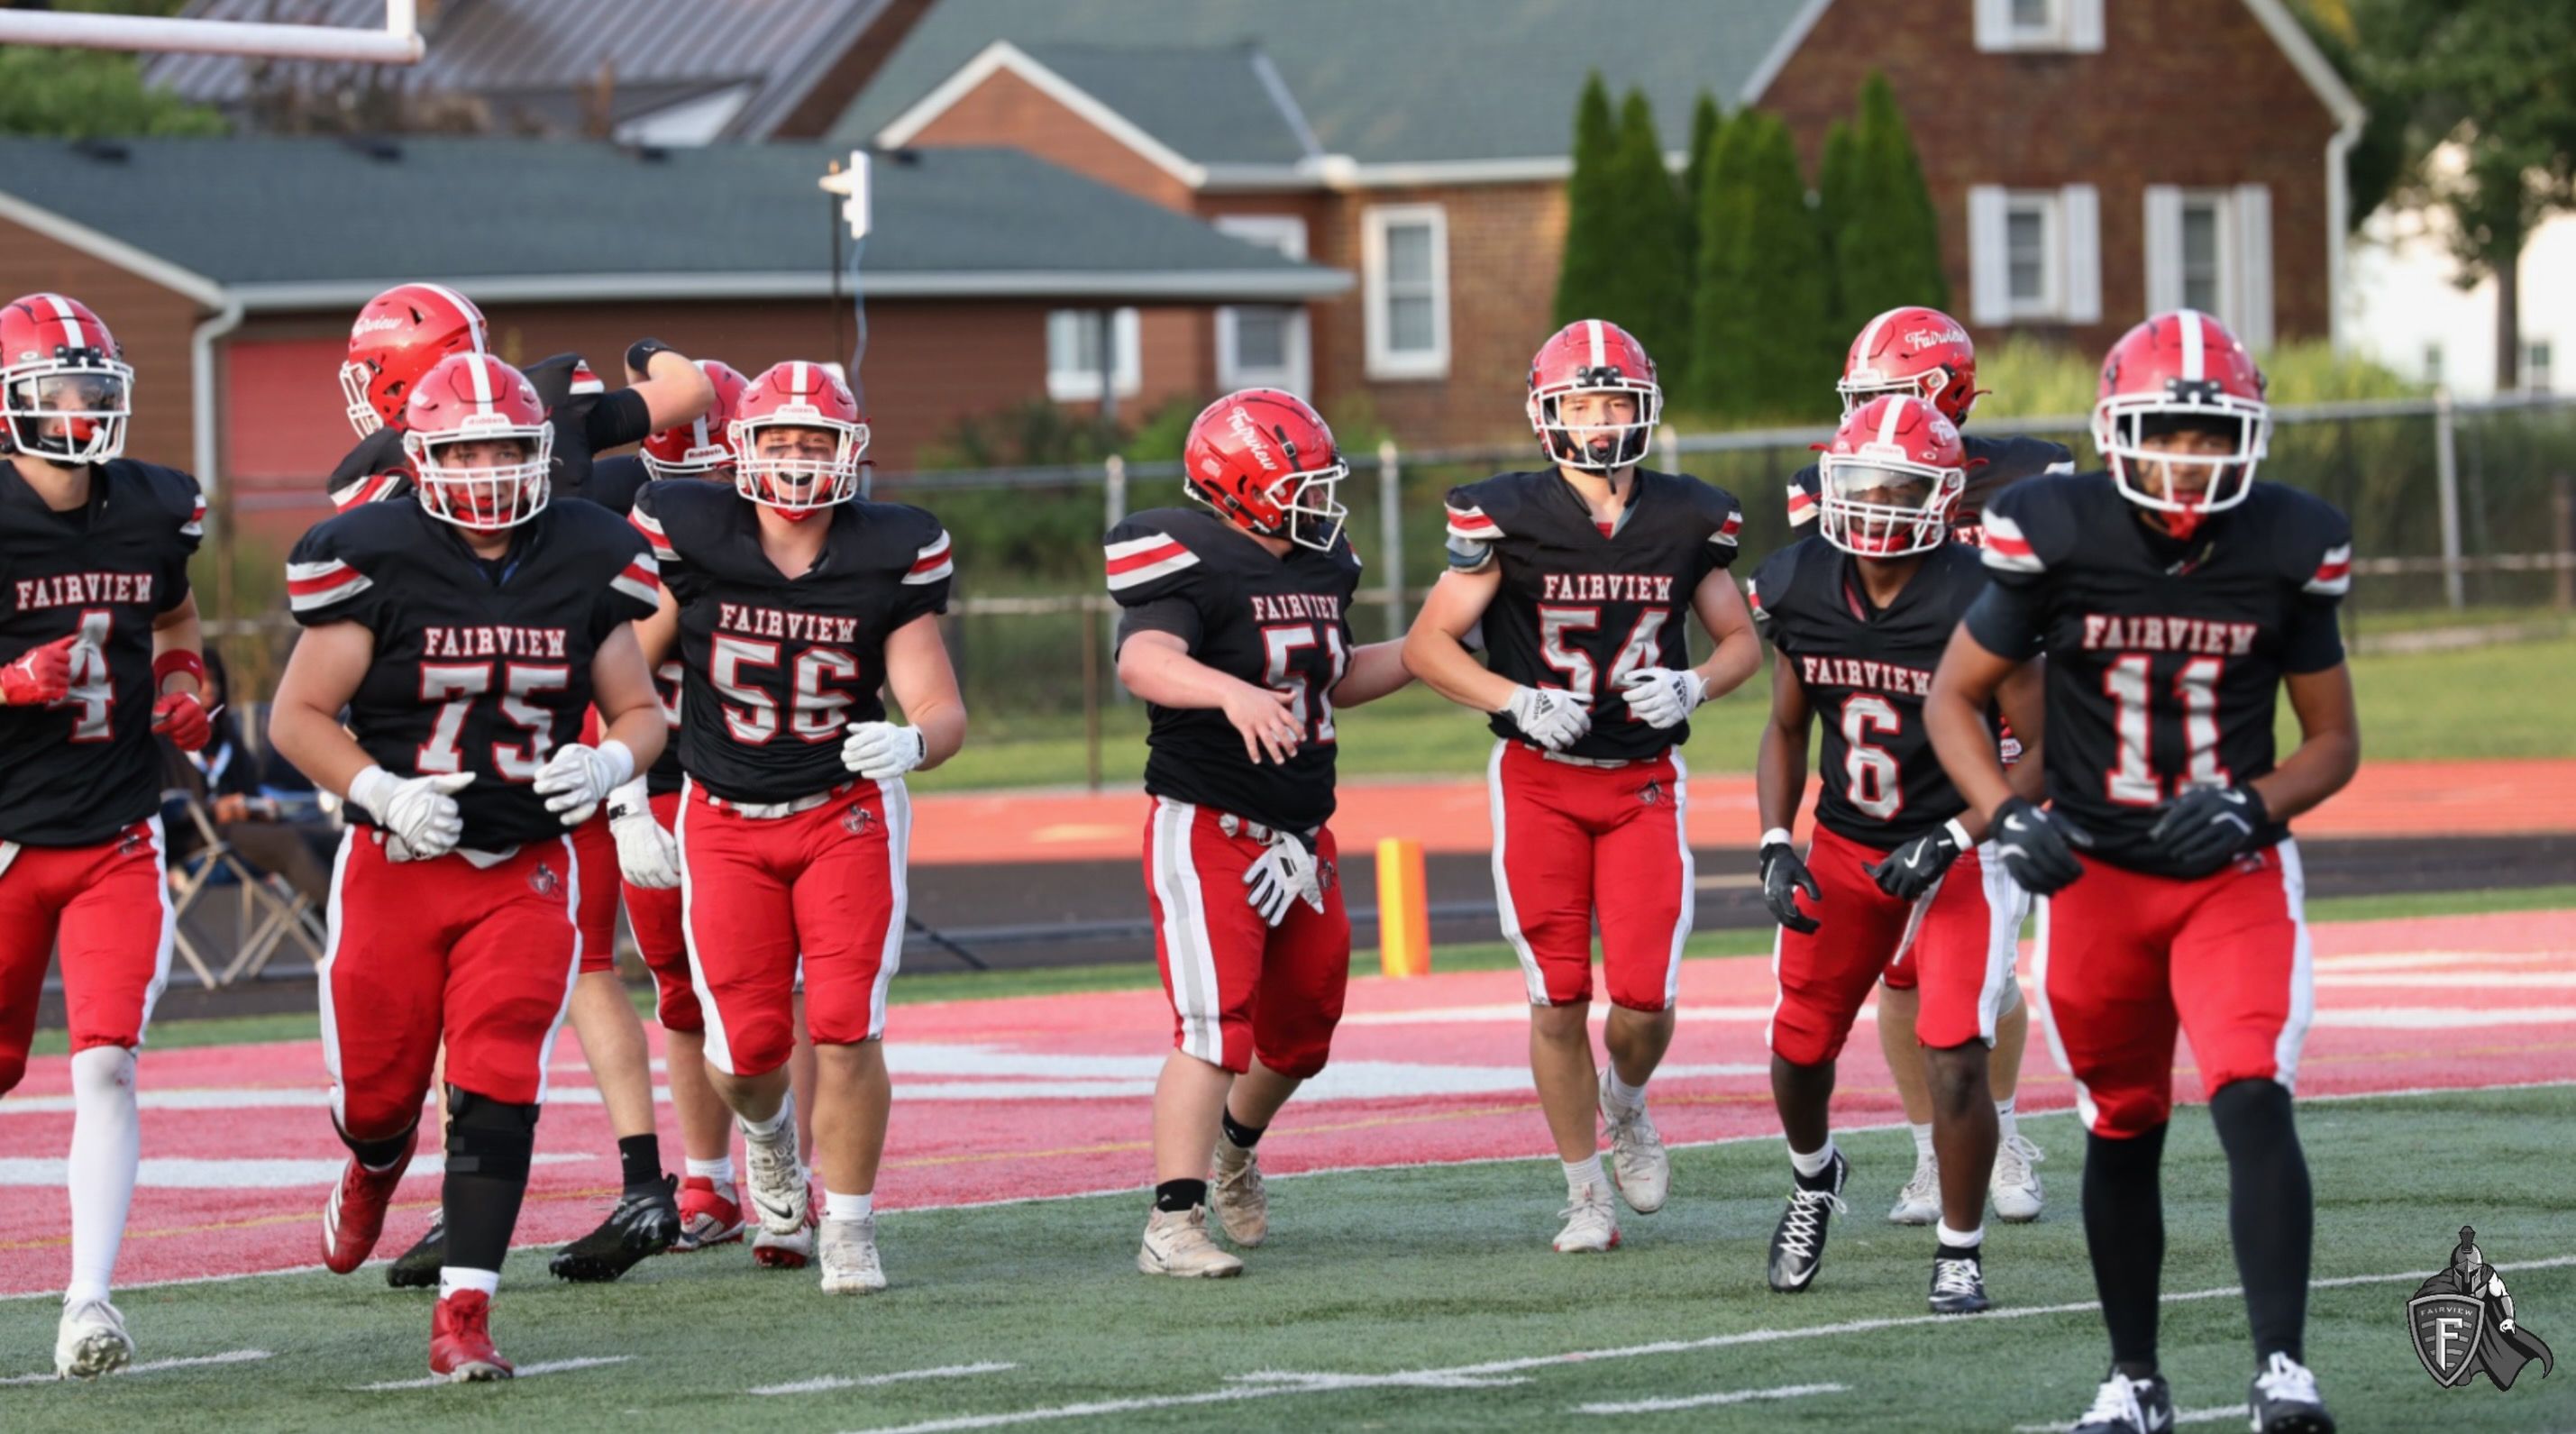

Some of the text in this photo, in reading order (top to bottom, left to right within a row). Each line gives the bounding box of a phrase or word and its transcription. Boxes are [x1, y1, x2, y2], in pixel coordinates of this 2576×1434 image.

[1226, 405, 1278, 470] Fairview
[15, 571, 152, 611] FAIRVIEW
[1250, 592, 1340, 621] FAIRVIEW
[1542, 573, 1675, 602] FAIRVIEW
[424, 625, 567, 658] FAIRVIEW
[718, 602, 858, 644] FAIRVIEW
[2081, 614, 2257, 656] FAIRVIEW
[48, 608, 115, 743] 4
[709, 631, 860, 747] 56
[1260, 623, 1345, 745] 51
[1537, 602, 1670, 723] 54
[1803, 656, 1932, 697] FAIRVIEW
[415, 661, 571, 784] 75
[2103, 653, 2232, 805] 11
[1841, 691, 1905, 822] 6
